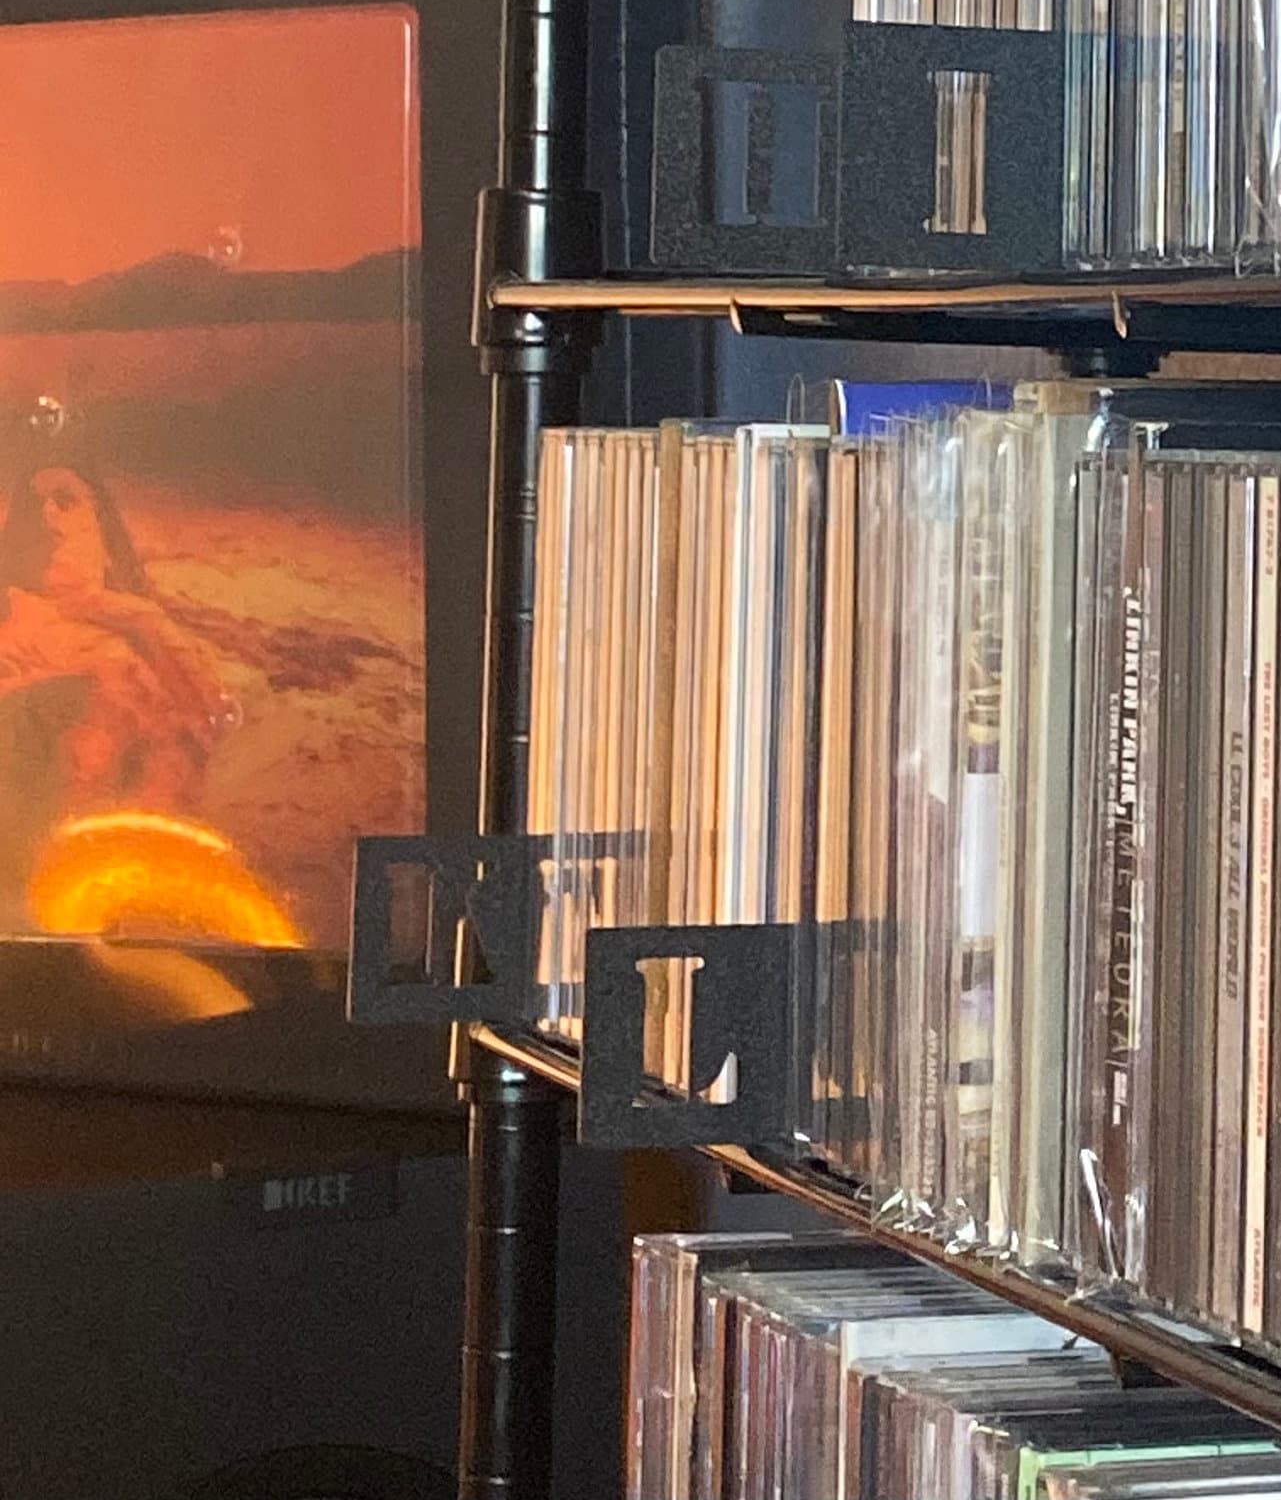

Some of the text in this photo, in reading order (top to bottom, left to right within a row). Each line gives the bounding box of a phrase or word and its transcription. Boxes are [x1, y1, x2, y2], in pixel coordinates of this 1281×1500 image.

[1123, 599, 1142, 708] LINKIN
[1119, 718, 1138, 805] PARK
[1111, 831, 1137, 1053] METEORA
[631, 955, 738, 1108] L
